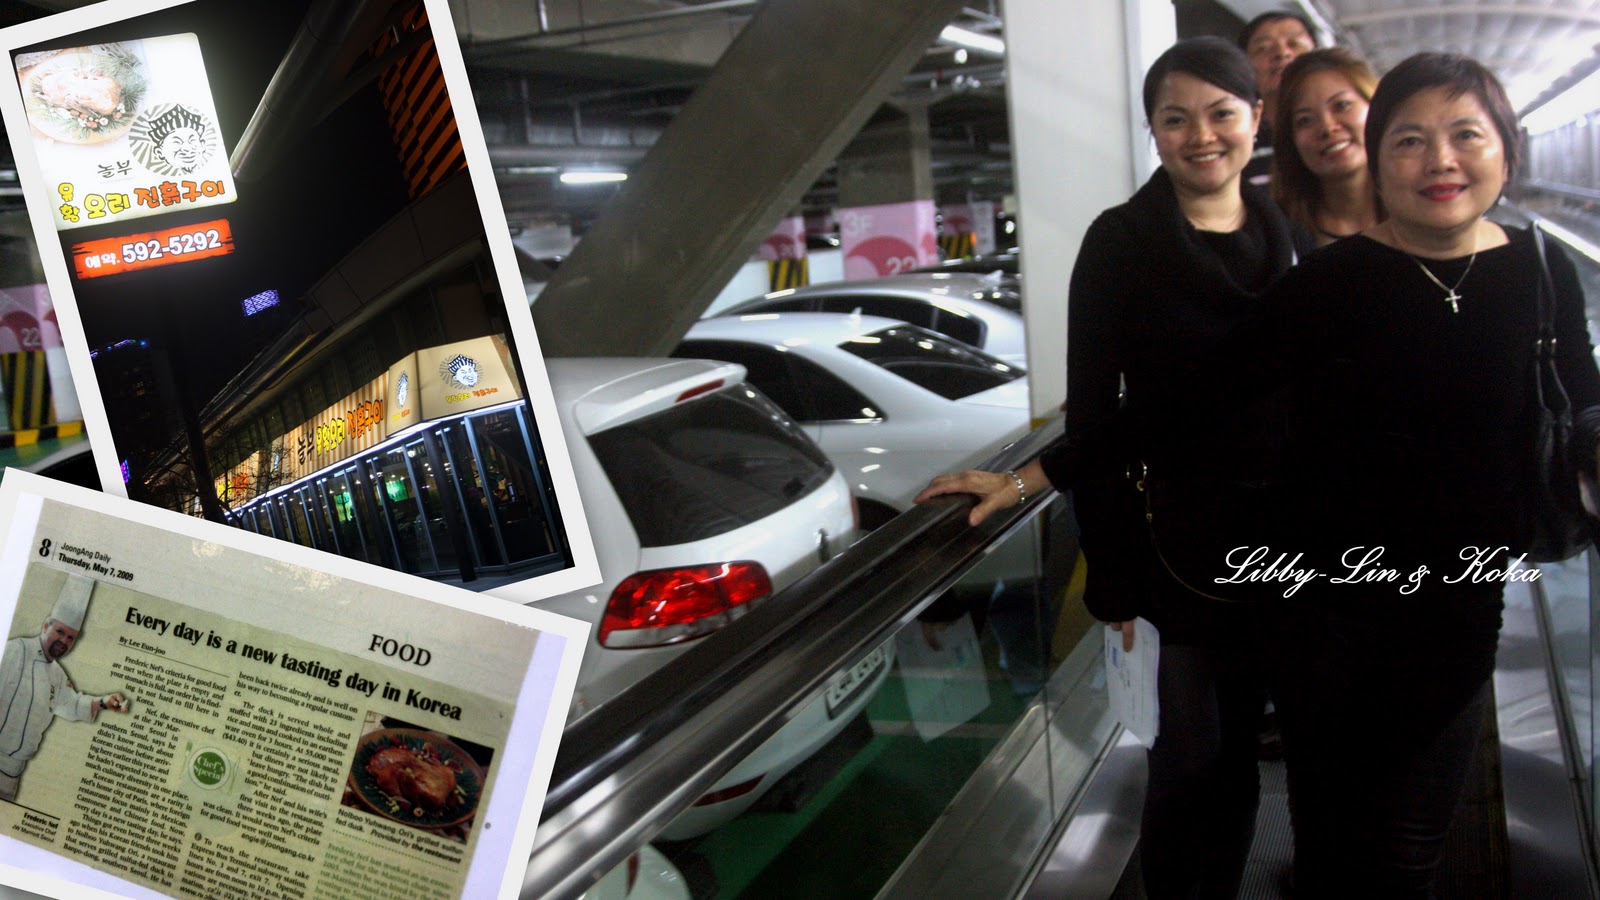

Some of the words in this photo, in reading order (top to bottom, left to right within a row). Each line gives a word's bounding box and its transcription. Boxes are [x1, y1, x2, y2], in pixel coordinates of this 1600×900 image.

[97, 160, 133, 178] 놀부
[58, 182, 80, 222] 유황
[84, 192, 131, 219] 오리
[134, 180, 226, 208] 진흙구이
[122, 229, 222, 264] 592-5292
[39, 538, 52, 557] 8
[61, 543, 94, 559] JoongAng
[94, 551, 111, 564] Daily
[59, 553, 91, 570] Thursday,
[92, 563, 109, 576] May
[110, 568, 115, 577] 7,
[116, 570, 134, 581] 2009
[119, 636, 128, 645] By
[129, 639, 140, 647] Lee
[141, 643, 166, 655] Eun-joo
[368, 634, 431, 666] FOOD
[125, 607, 170, 636] Every
[173, 622, 204, 646] day
[206, 630, 222, 649] is
[226, 640, 237, 654] a
[241, 644, 277, 664] new
[281, 653, 342, 688] tasting
[346, 672, 379, 697] day
[382, 682, 401, 702] in
[405, 689, 462, 721] Korea
[125, 656, 149, 668] Frederic
[149, 664, 164, 673] Nef's
[165, 670, 186, 680] criteria
[196, 679, 212, 687] good
[212, 682, 227, 692] food
[124, 675, 148, 686] stomach
[175, 691, 192, 700] order
[192, 694, 200, 702] he
[137, 670, 153, 679] when
[155, 674, 165, 682] the
[166, 678, 182, 687] plate
[191, 687, 210, 697] empty
[236, 680, 246, 689] his
[248, 685, 261, 694] way
[269, 690, 300, 706] becoming
[306, 703, 329, 714] regular
[239, 671, 254, 682] been
[255, 676, 270, 686] back
[271, 682, 288, 692] twice
[288, 688, 312, 701] already
[313, 696, 326, 704] and
[334, 702, 349, 710] well
[125, 683, 136, 692] ing
[158, 693, 173, 703] hard
[196, 704, 210, 714] here
[212, 710, 219, 718] in
[141, 716, 152, 724] the
[160, 712, 170, 720] the
[171, 717, 200, 730] executive
[201, 726, 215, 734] chef
[230, 708, 251, 718] stuffed
[253, 715, 267, 724] with
[279, 722, 315, 738] ingredients
[316, 734, 348, 750] including
[239, 720, 251, 728] and
[251, 724, 265, 732] nuts
[266, 728, 278, 736] and
[278, 733, 302, 744] cooked
[302, 738, 309, 746] in
[243, 701, 255, 710] The
[258, 706, 274, 716] duck
[288, 716, 310, 727] served
[313, 724, 334, 735] whole
[337, 732, 351, 740] and
[225, 725, 240, 733] ware
[241, 730, 256, 739] oven
[258, 734, 267, 742] for
[328, 758, 342, 766] won
[263, 747, 290, 760] certainly
[298, 758, 320, 769] serious
[24, 812, 47, 825] Frederic
[48, 821, 58, 829] Nef
[338, 808, 363, 822] Nolboo
[365, 817, 396, 834] Yuhwang
[398, 828, 414, 839] Ori's
[416, 836, 440, 847] grilled
[336, 817, 347, 826] fed
[370, 829, 401, 844] Provided
[401, 839, 410, 848] by
[412, 844, 423, 852] the
[424, 848, 461, 864] restaurant
